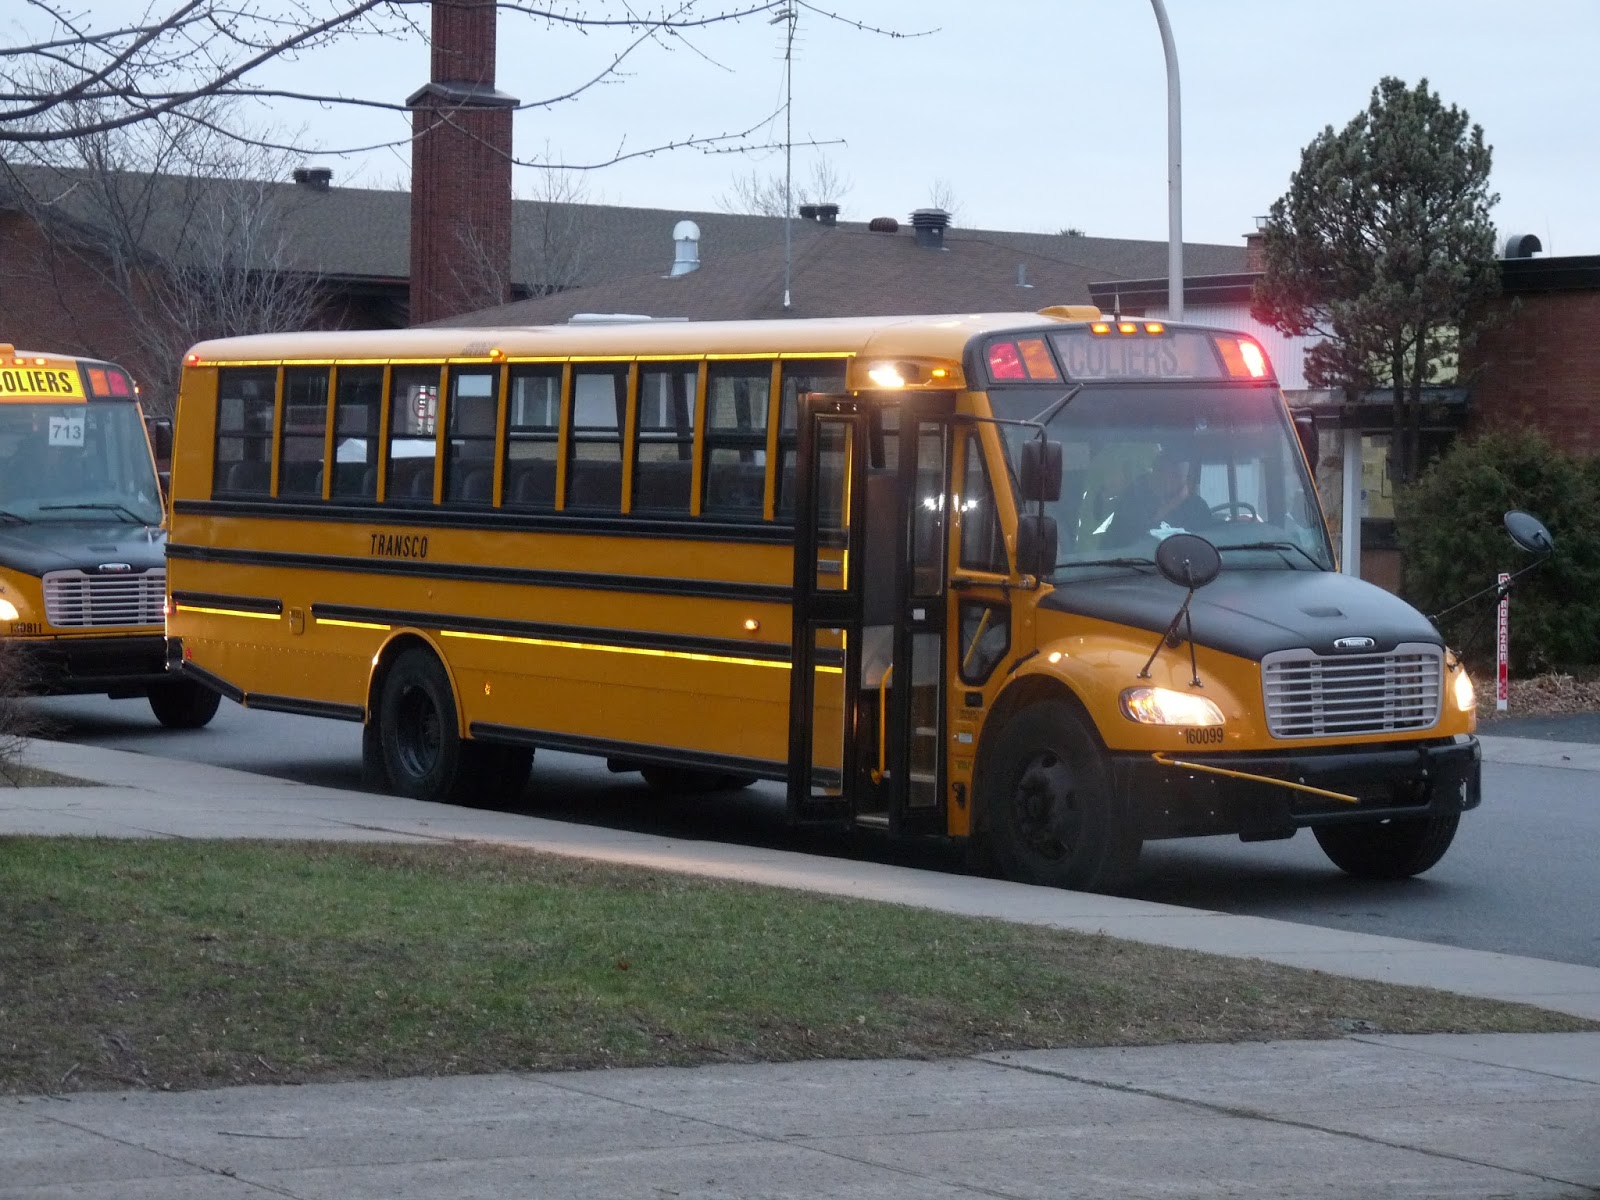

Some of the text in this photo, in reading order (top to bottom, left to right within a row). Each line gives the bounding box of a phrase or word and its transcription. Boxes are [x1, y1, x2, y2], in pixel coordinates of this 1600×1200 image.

[0, 370, 73, 393] OLIERS
[52, 424, 82, 440] 713
[371, 533, 428, 558] TRANSCO
[9, 621, 42, 634] 130811
[1184, 727, 1224, 744] 160099
